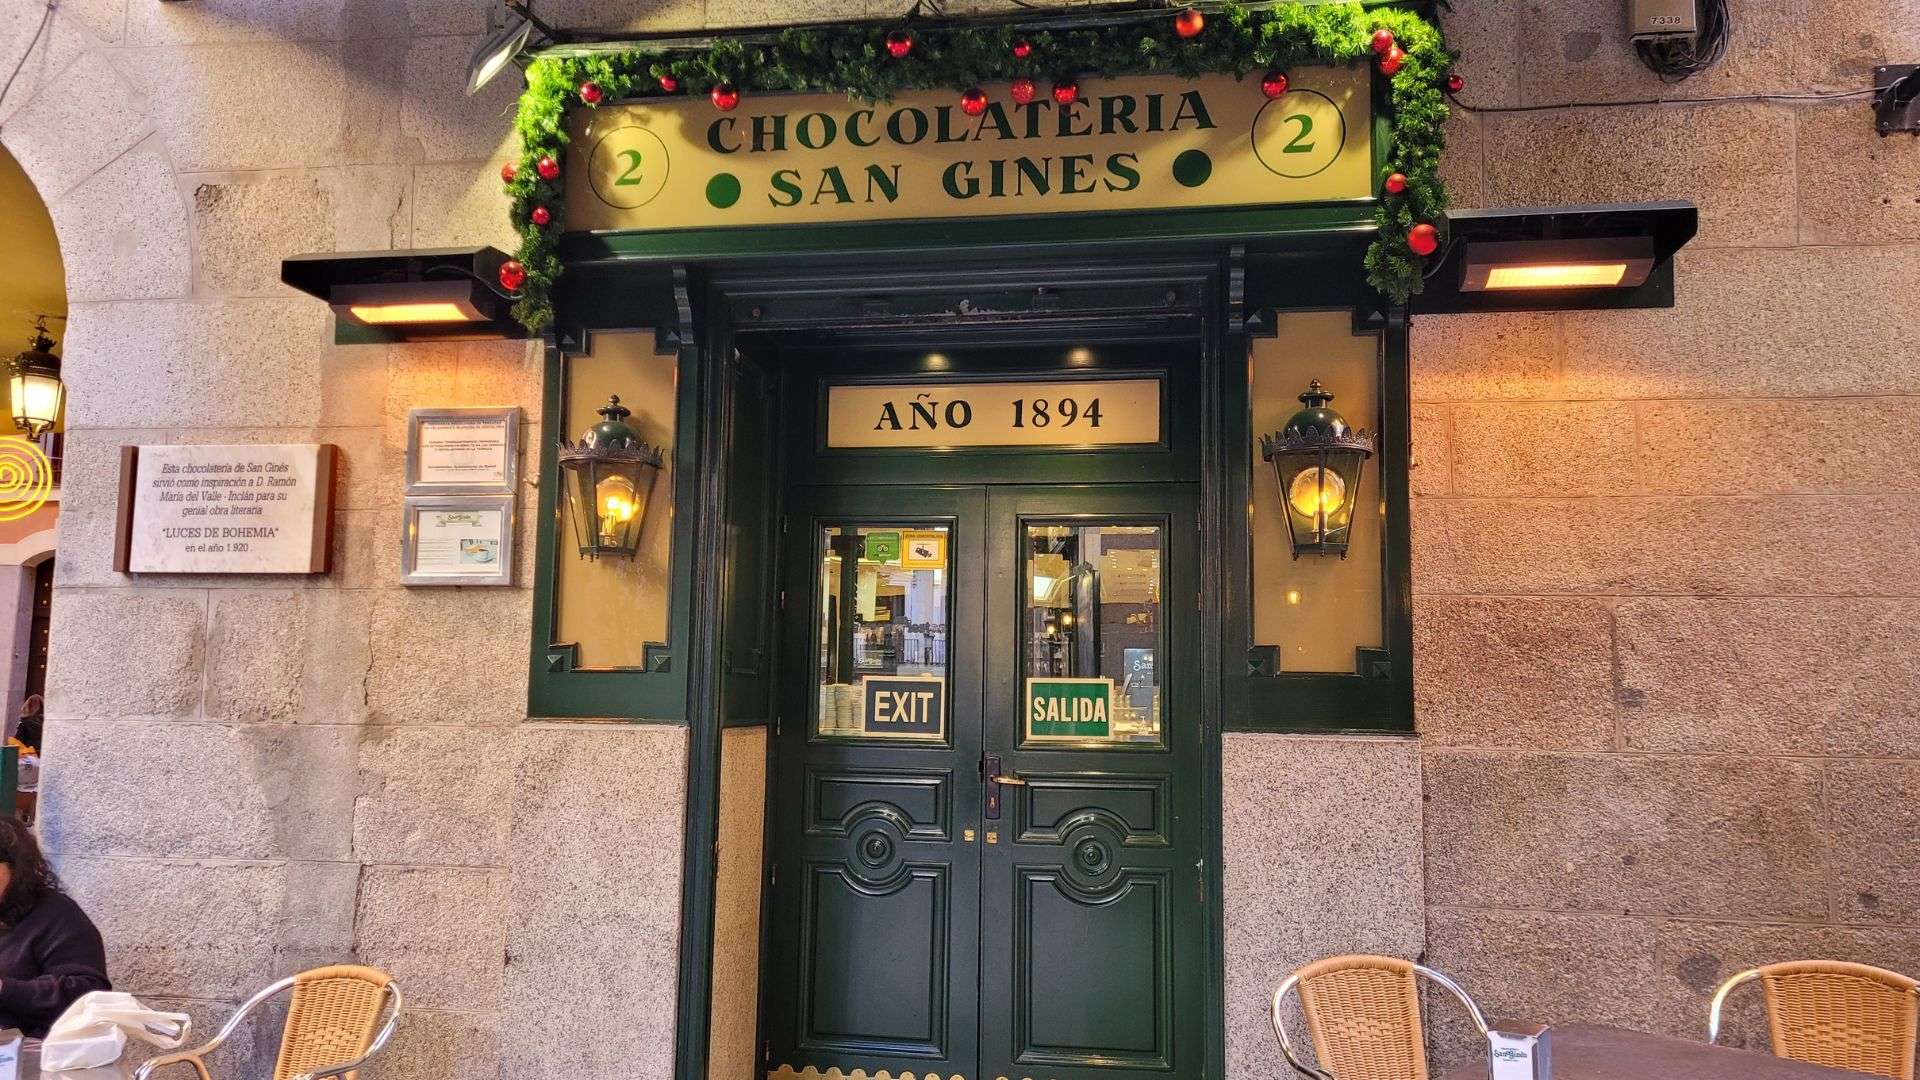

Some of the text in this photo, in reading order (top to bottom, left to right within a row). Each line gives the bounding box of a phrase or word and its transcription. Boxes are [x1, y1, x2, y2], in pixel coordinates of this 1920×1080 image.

[1651, 16, 1681, 25] 7338
[706, 89, 1218, 154] CHOCOLATERIA
[1281, 113, 1316, 153] 2
[614, 148, 643, 187] 2
[767, 152, 1141, 208] SAN GINES
[873, 393, 1104, 431] AÑO 1894
[161, 463, 180, 474] Esta
[234, 462, 246, 473] de
[247, 462, 263, 473] San
[265, 462, 289, 473] Ginés
[176, 479, 200, 488] como
[248, 479, 254, 487] a
[266, 476, 297, 487] Ramón
[186, 490, 199, 501] del
[201, 490, 222, 501] Valle
[255, 492, 275, 503] para
[277, 492, 288, 501] su
[182, 505, 262, 518] genial obra literaria
[204, 527, 220, 538] DE
[185, 544, 196, 552] en
[198, 543, 206, 552] el
[207, 543, 224, 552] año
[874, 690, 934, 724] EXIT
[1033, 696, 1107, 723] SALIDA
